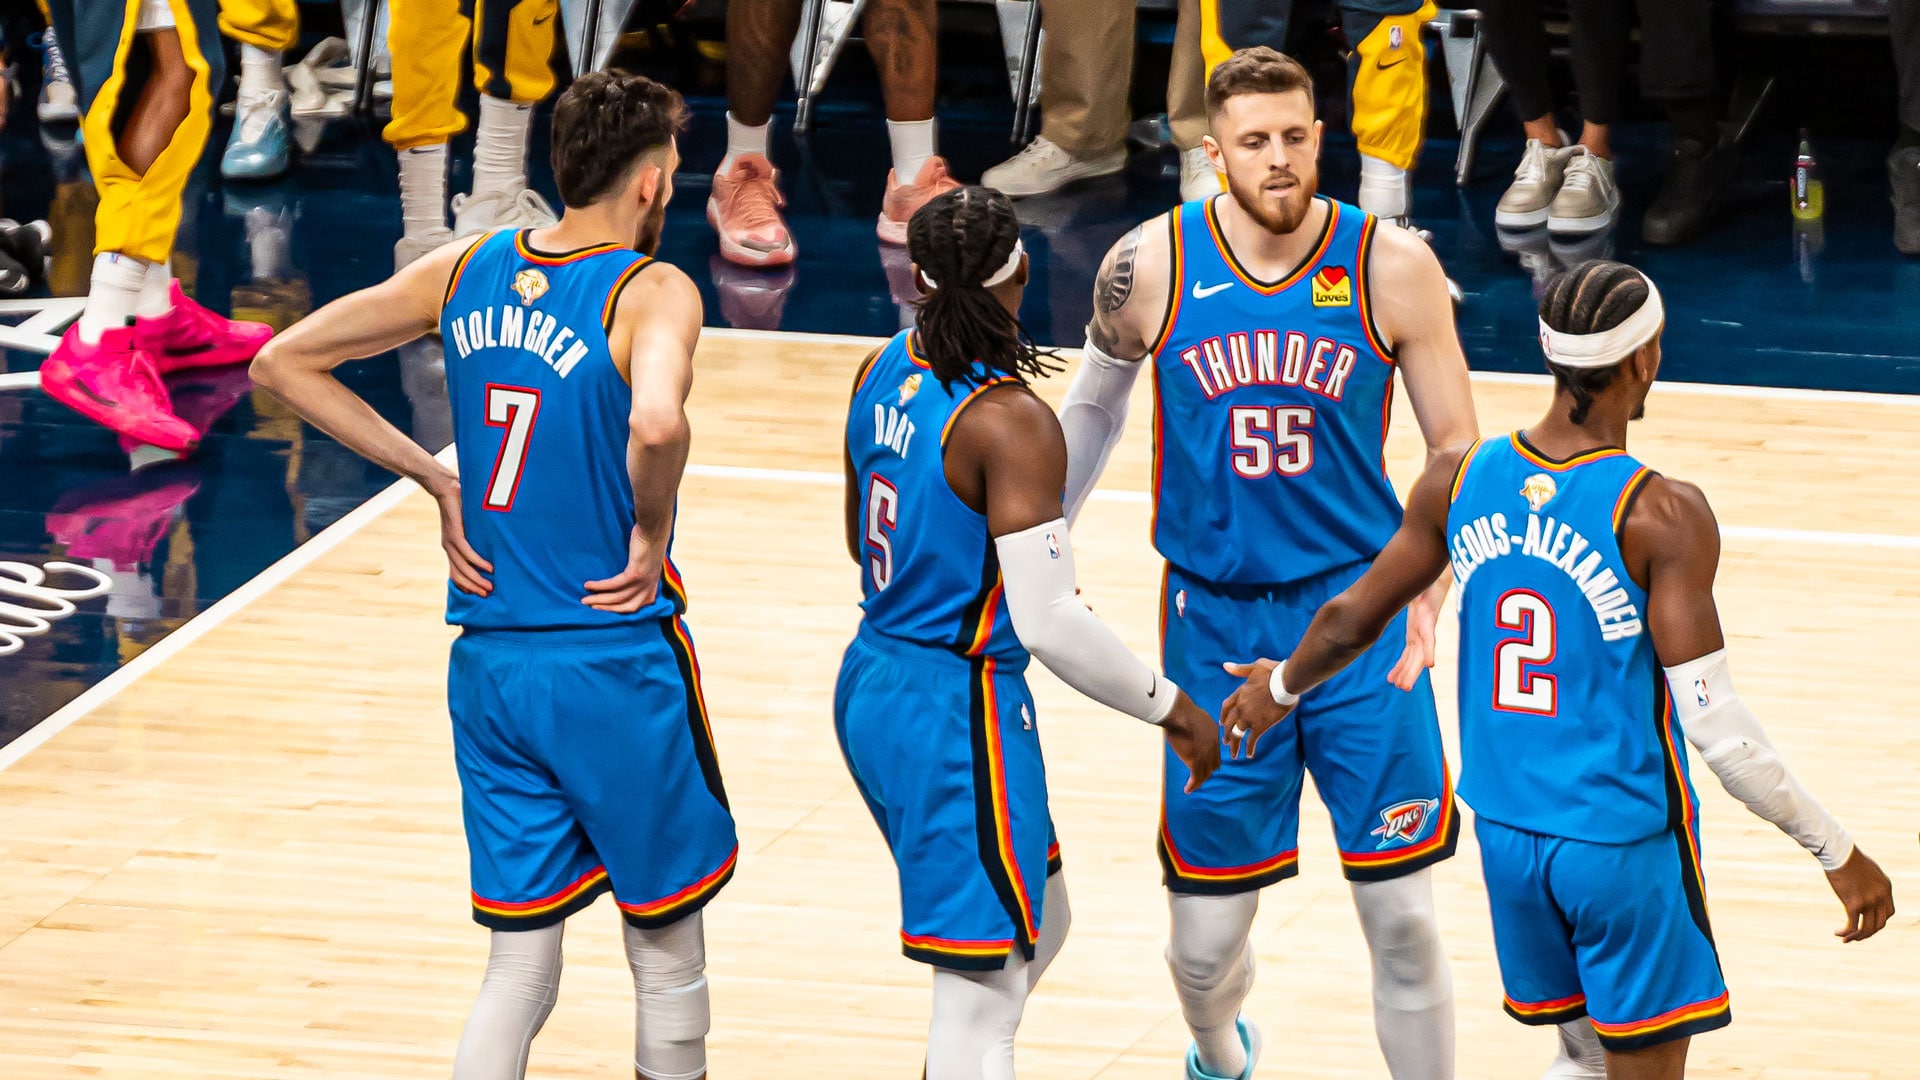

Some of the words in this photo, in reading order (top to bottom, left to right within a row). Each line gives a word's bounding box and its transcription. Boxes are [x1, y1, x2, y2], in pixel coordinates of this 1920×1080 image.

[451, 304, 590, 379] HOLMGREN
[1179, 329, 1357, 402] THUNDER
[482, 382, 542, 513] 7
[874, 403, 916, 460] DORT
[1229, 405, 1315, 480] 55
[865, 472, 898, 593] 5
[1451, 512, 1643, 642] GEOUS-ALEXANDER
[1492, 587, 1558, 719] 2
